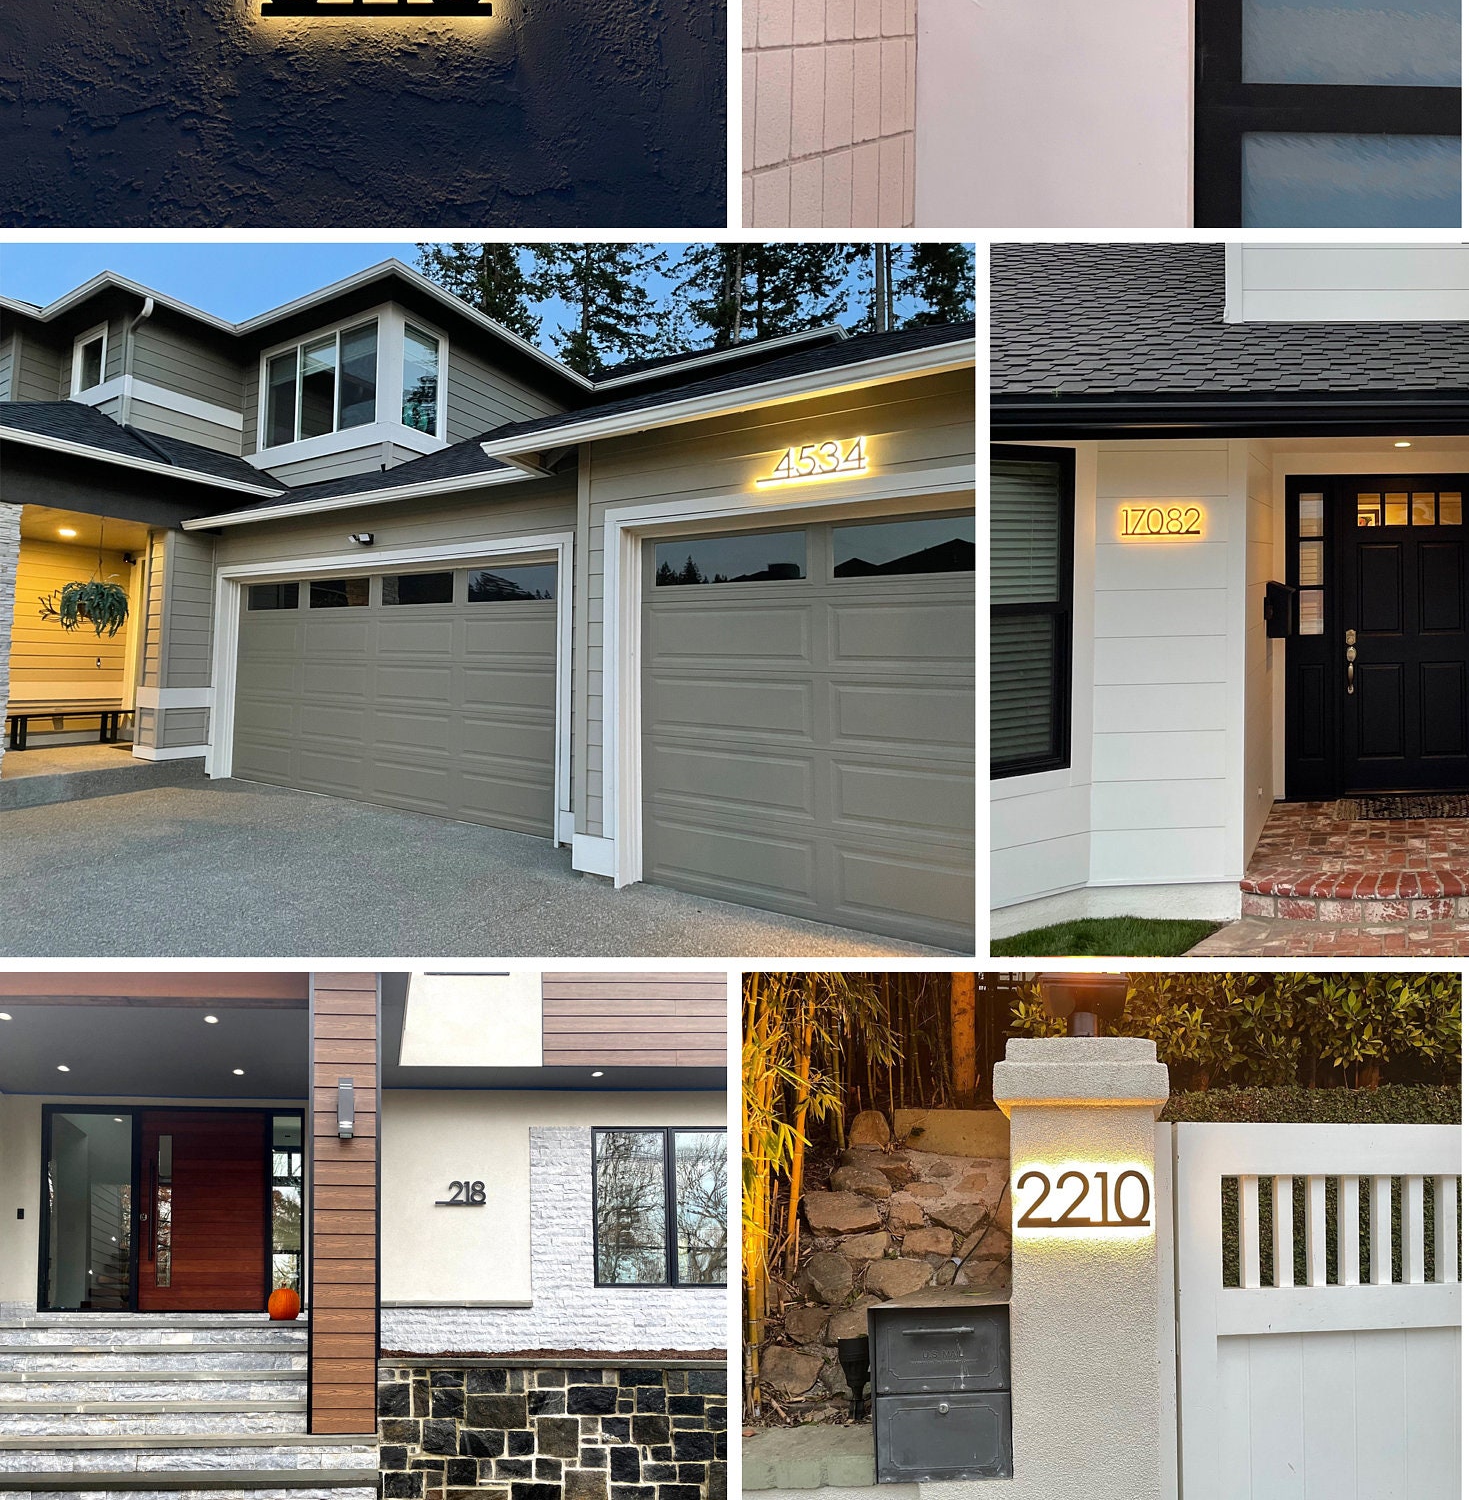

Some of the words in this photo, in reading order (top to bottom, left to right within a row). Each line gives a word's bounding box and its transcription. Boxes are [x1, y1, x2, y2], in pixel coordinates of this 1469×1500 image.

[773, 437, 865, 478] 4534
[1122, 508, 1200, 535] 17082
[449, 1180, 487, 1204] 218
[1017, 1170, 1150, 1226] 2210
